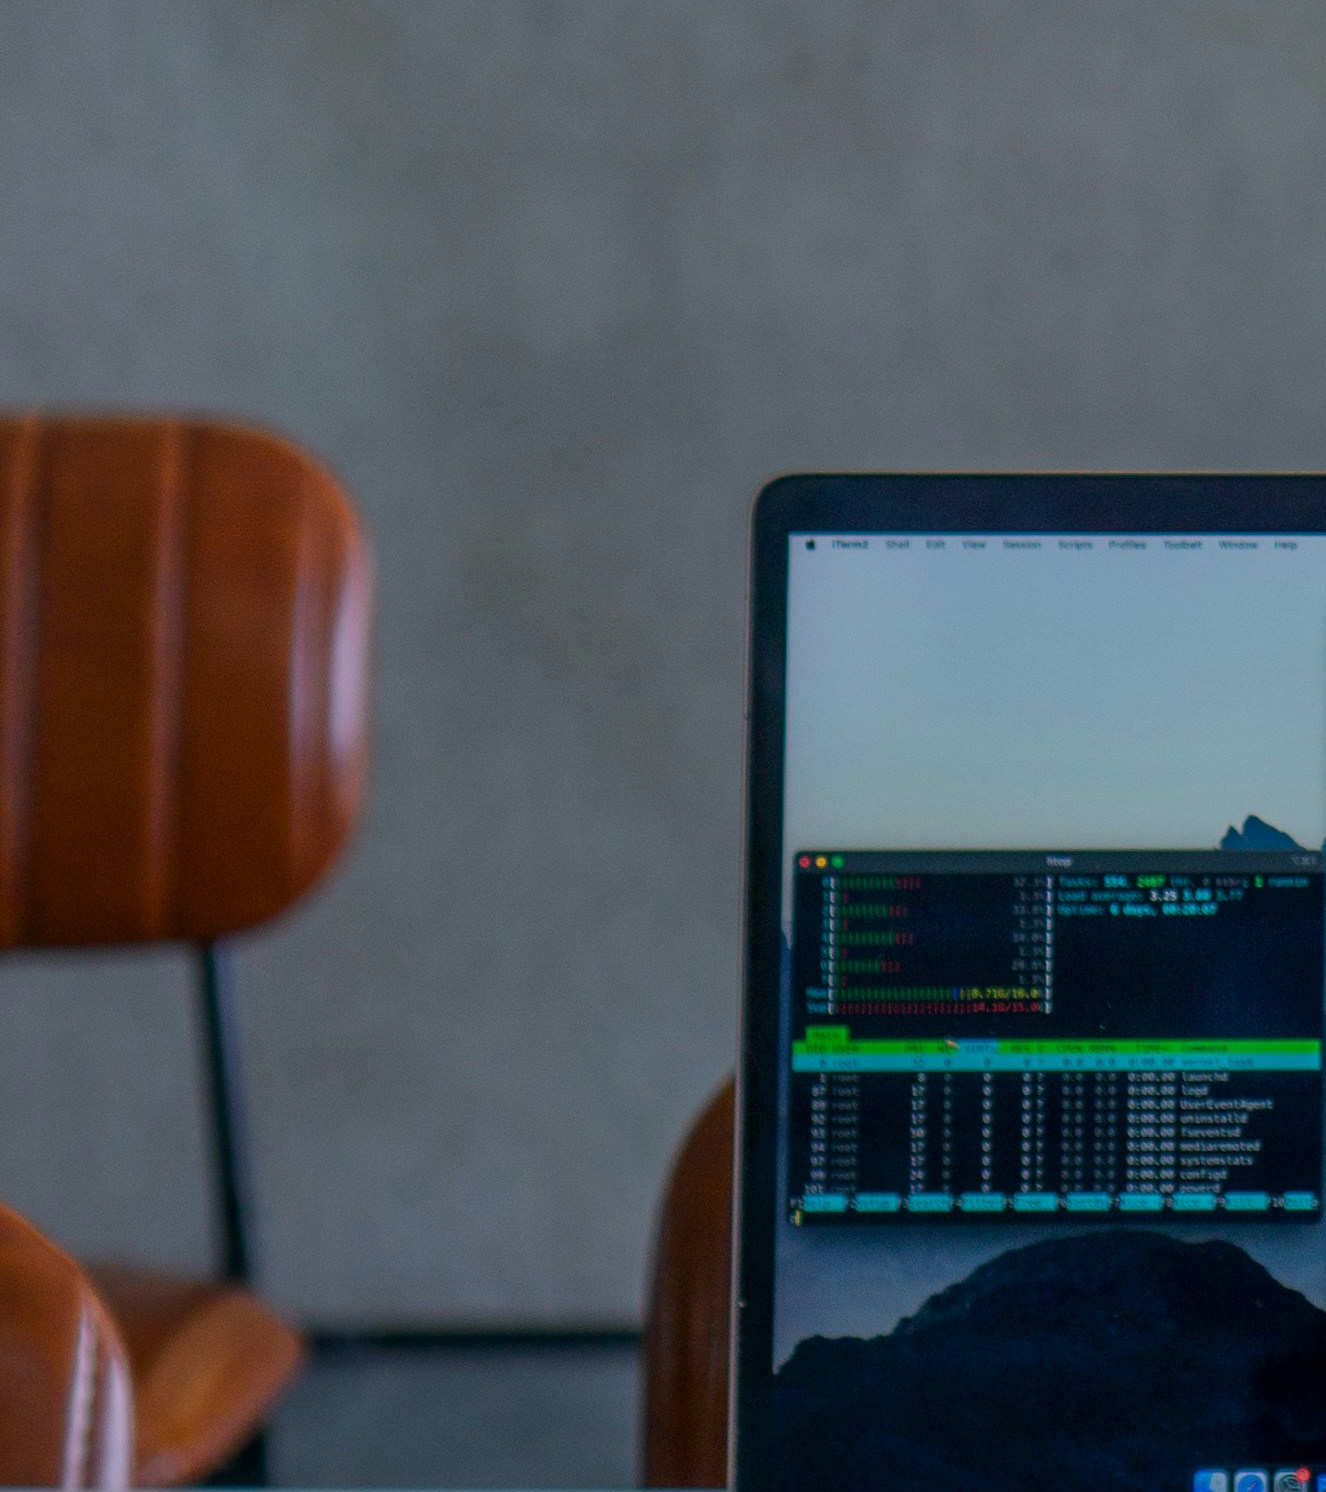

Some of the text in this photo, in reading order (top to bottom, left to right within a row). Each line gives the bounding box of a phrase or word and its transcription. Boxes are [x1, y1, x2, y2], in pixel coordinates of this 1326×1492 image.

[886, 540, 910, 549] Shell
[926, 540, 946, 549] Edit
[962, 541, 986, 549] View
[1003, 541, 1041, 549] Session
[1058, 541, 1093, 550] Scripts
[1109, 540, 1147, 549] Profiles
[1219, 541, 1258, 549] Window
[1274, 542, 1297, 550] Help
[1180, 1098, 1273, 1111] UserEventAgent
